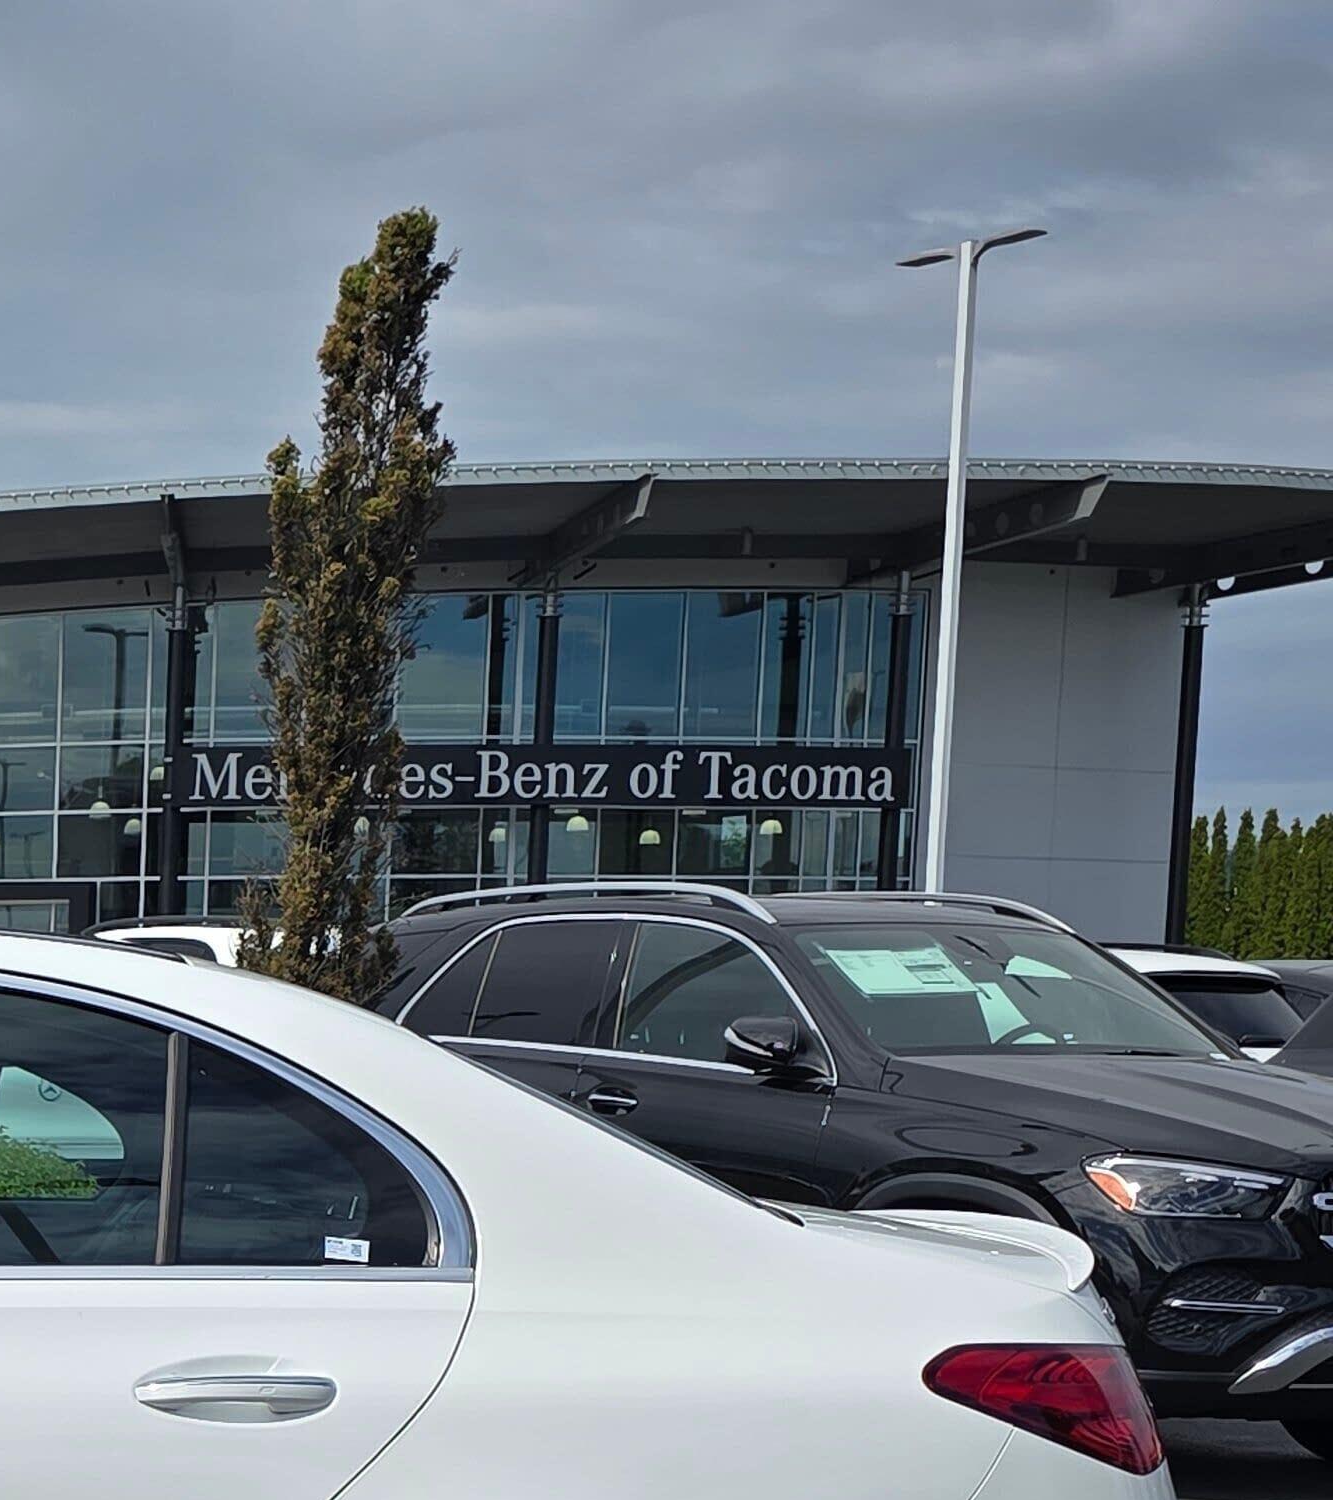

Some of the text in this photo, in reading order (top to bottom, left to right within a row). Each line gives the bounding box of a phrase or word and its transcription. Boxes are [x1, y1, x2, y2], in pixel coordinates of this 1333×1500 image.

[188, 750, 895, 801] Mees-Benz of Tacoma
